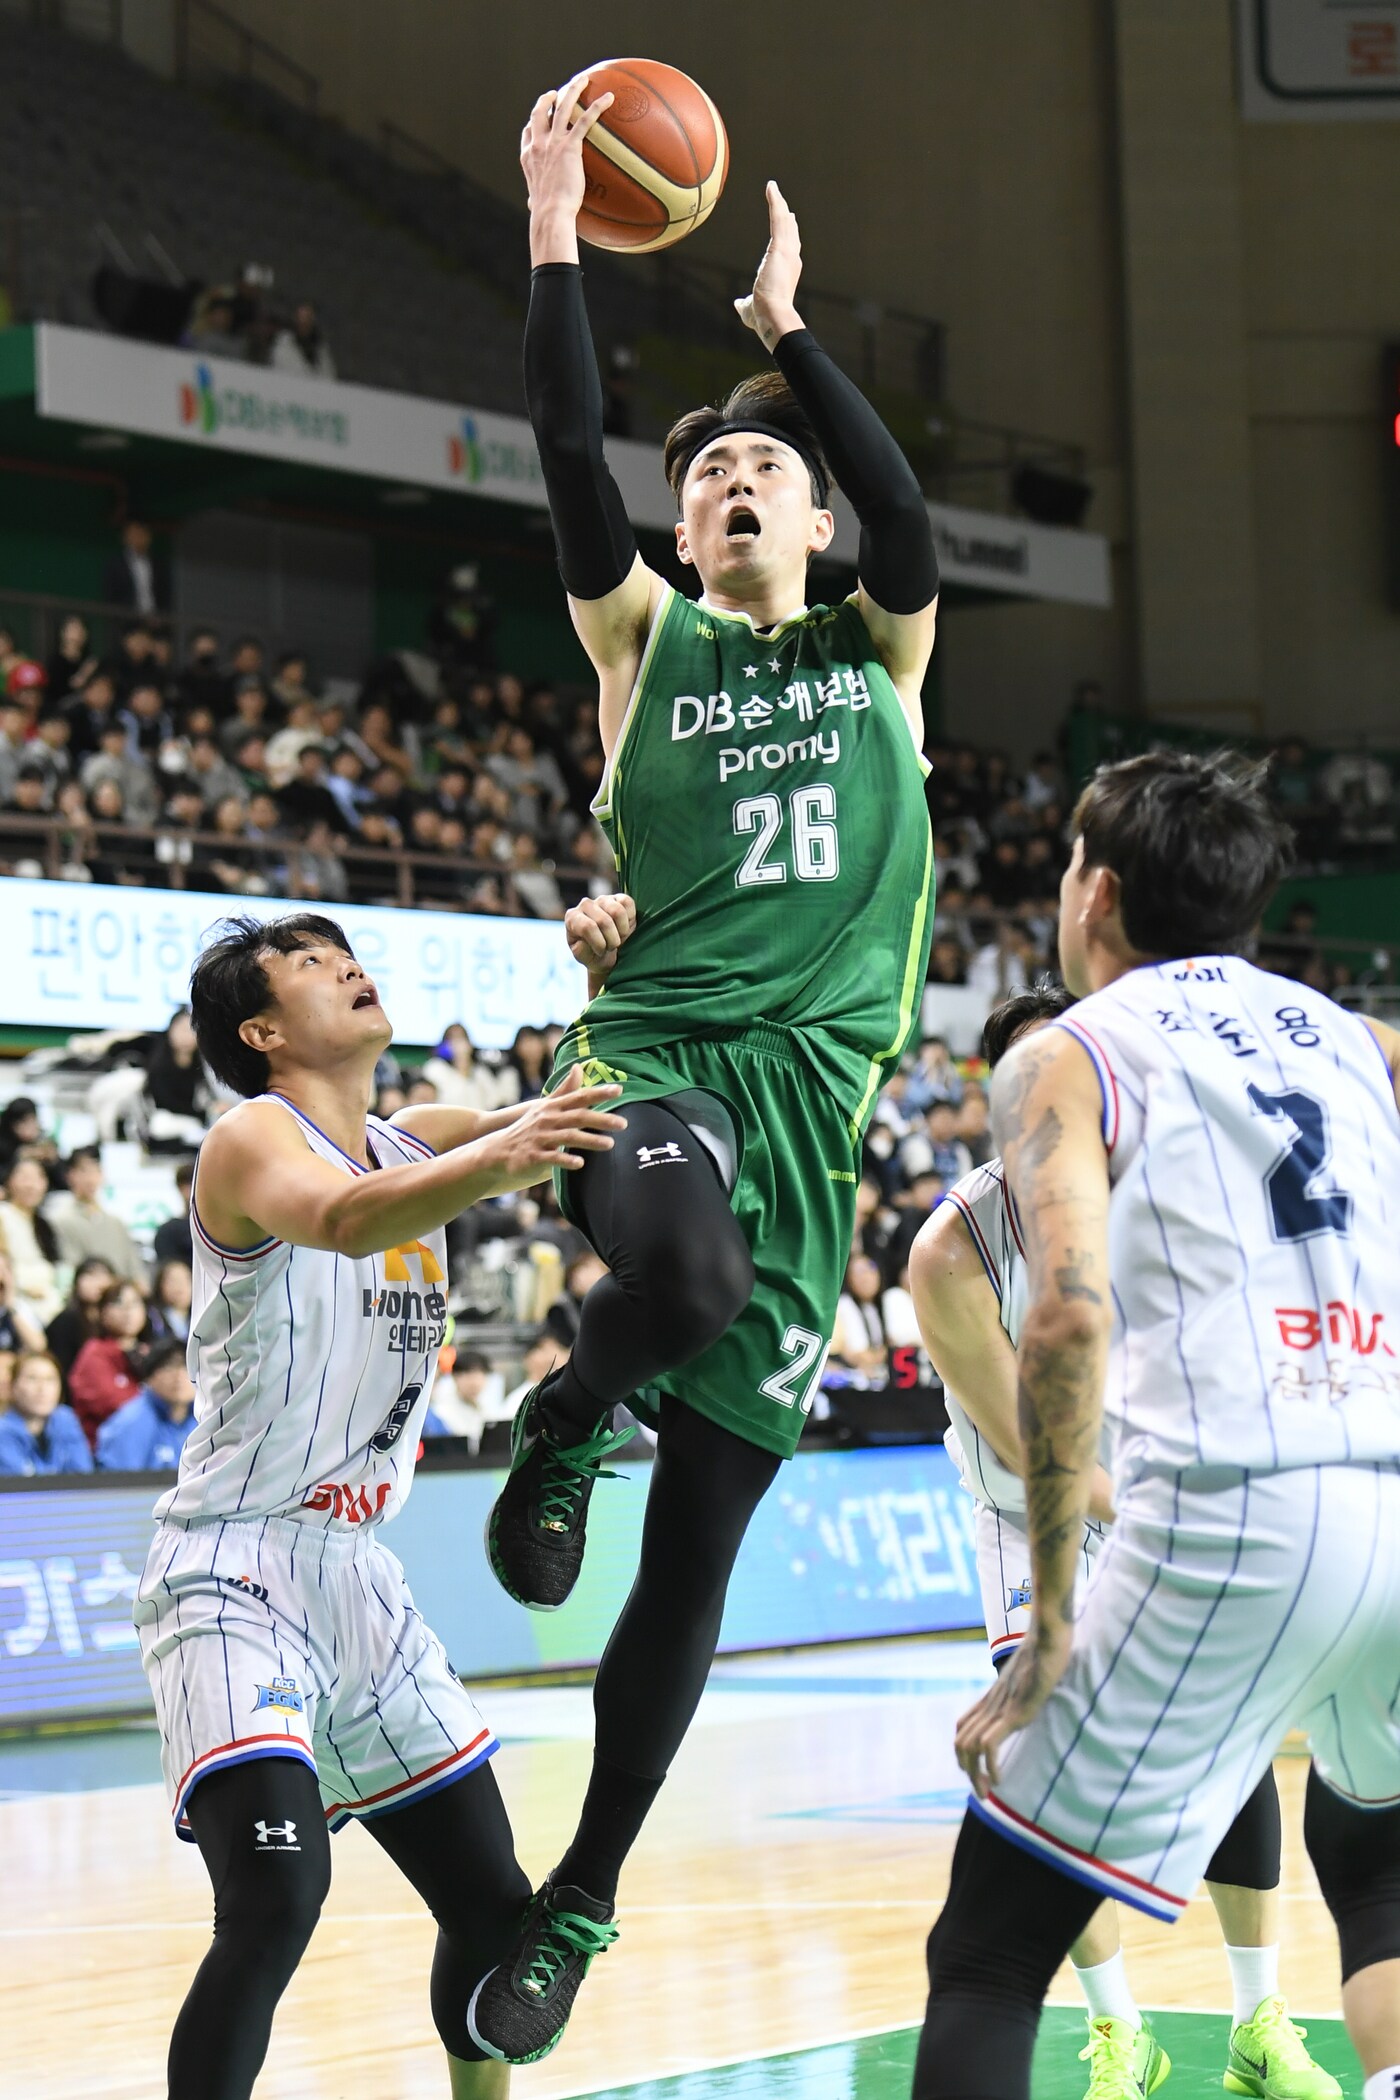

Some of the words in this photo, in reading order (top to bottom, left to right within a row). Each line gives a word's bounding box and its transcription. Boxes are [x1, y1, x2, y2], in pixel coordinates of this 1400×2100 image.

[671, 668, 872, 741] DB손해보험
[719, 730, 840, 783] promy
[733, 783, 839, 888] 26
[1244, 1077, 1354, 1244] 2
[363, 1289, 448, 1321] Home
[254, 1685, 304, 1712] EGIS
[274, 1678, 295, 1690] KCC
